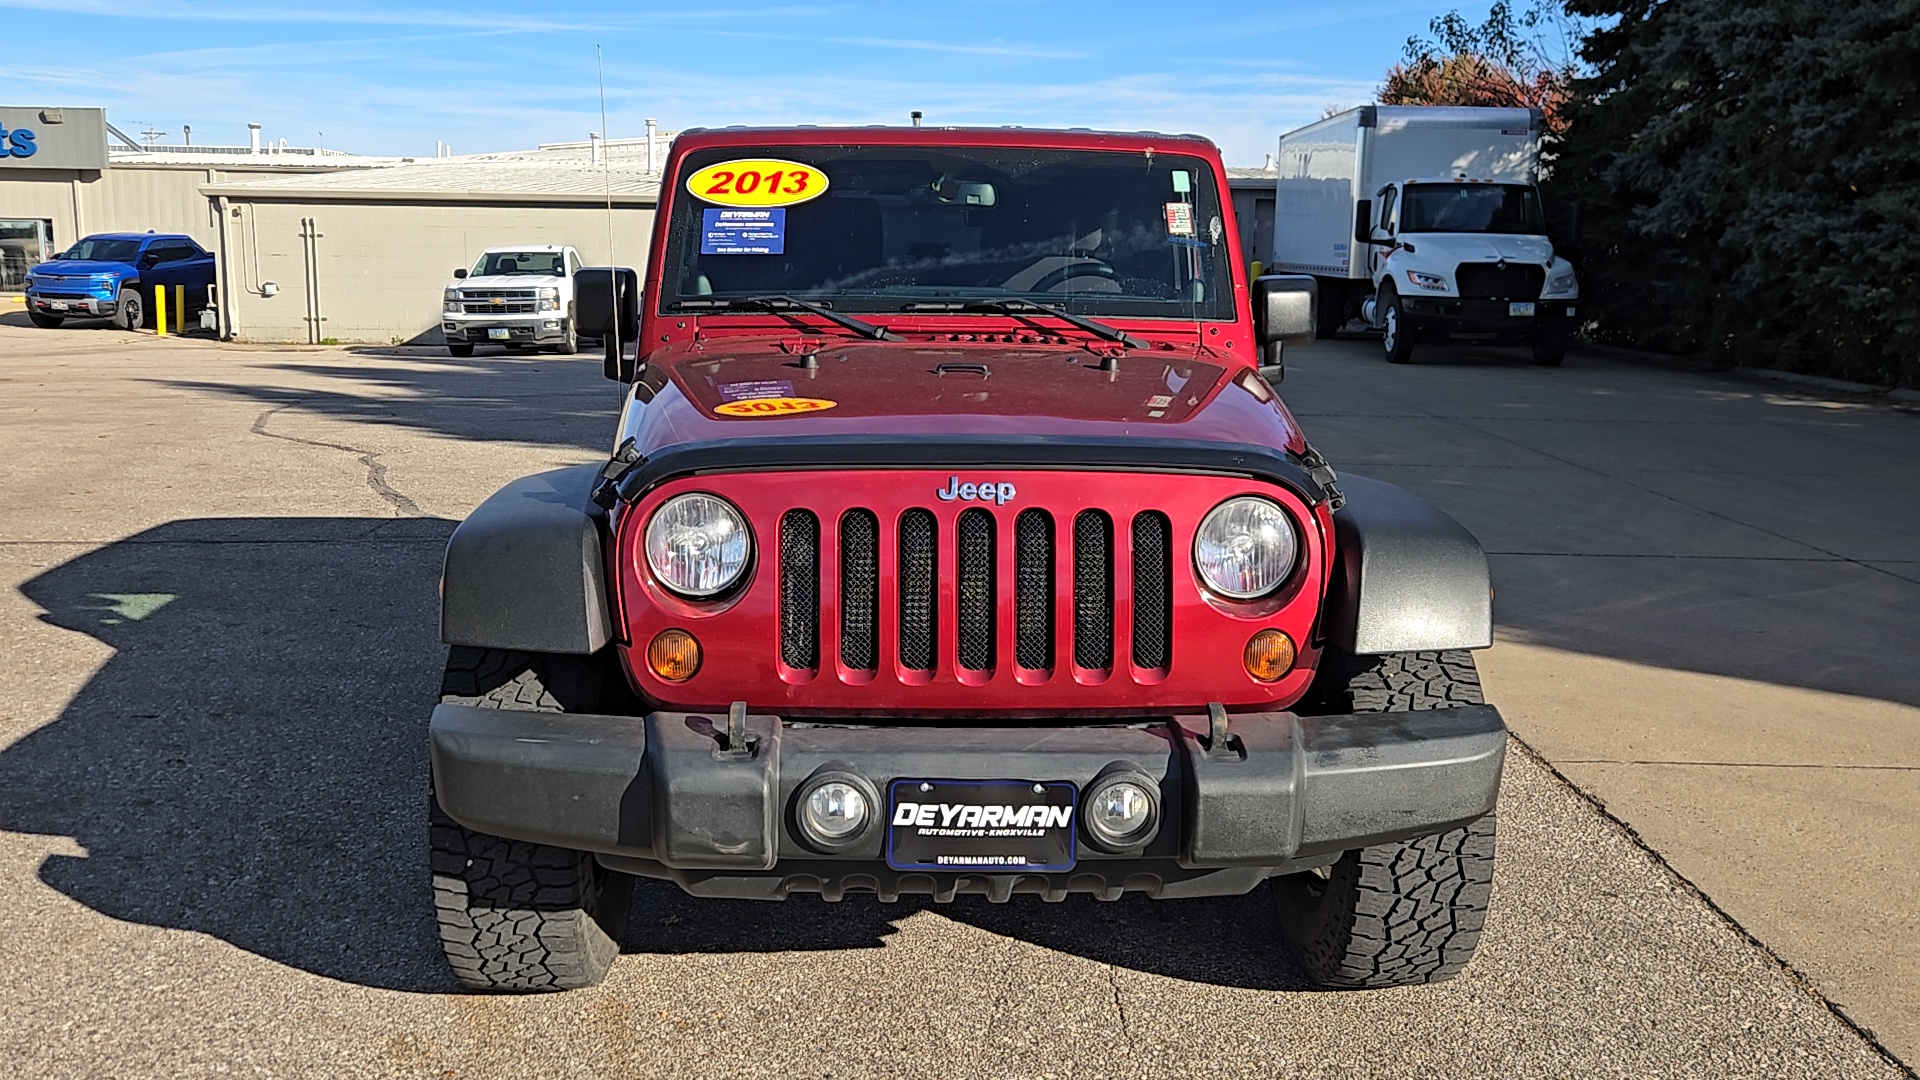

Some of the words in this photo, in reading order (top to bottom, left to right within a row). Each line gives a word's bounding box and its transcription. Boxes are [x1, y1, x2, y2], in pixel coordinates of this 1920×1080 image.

[705, 171, 809, 194] 2013
[936, 476, 1016, 506] Jeep
[892, 803, 1073, 828] DEYARMAN
[918, 828, 1045, 837] AUTOMOTIVE-KNOXVILLE
[937, 856, 1026, 865] DEYARMANAUTO.COM
